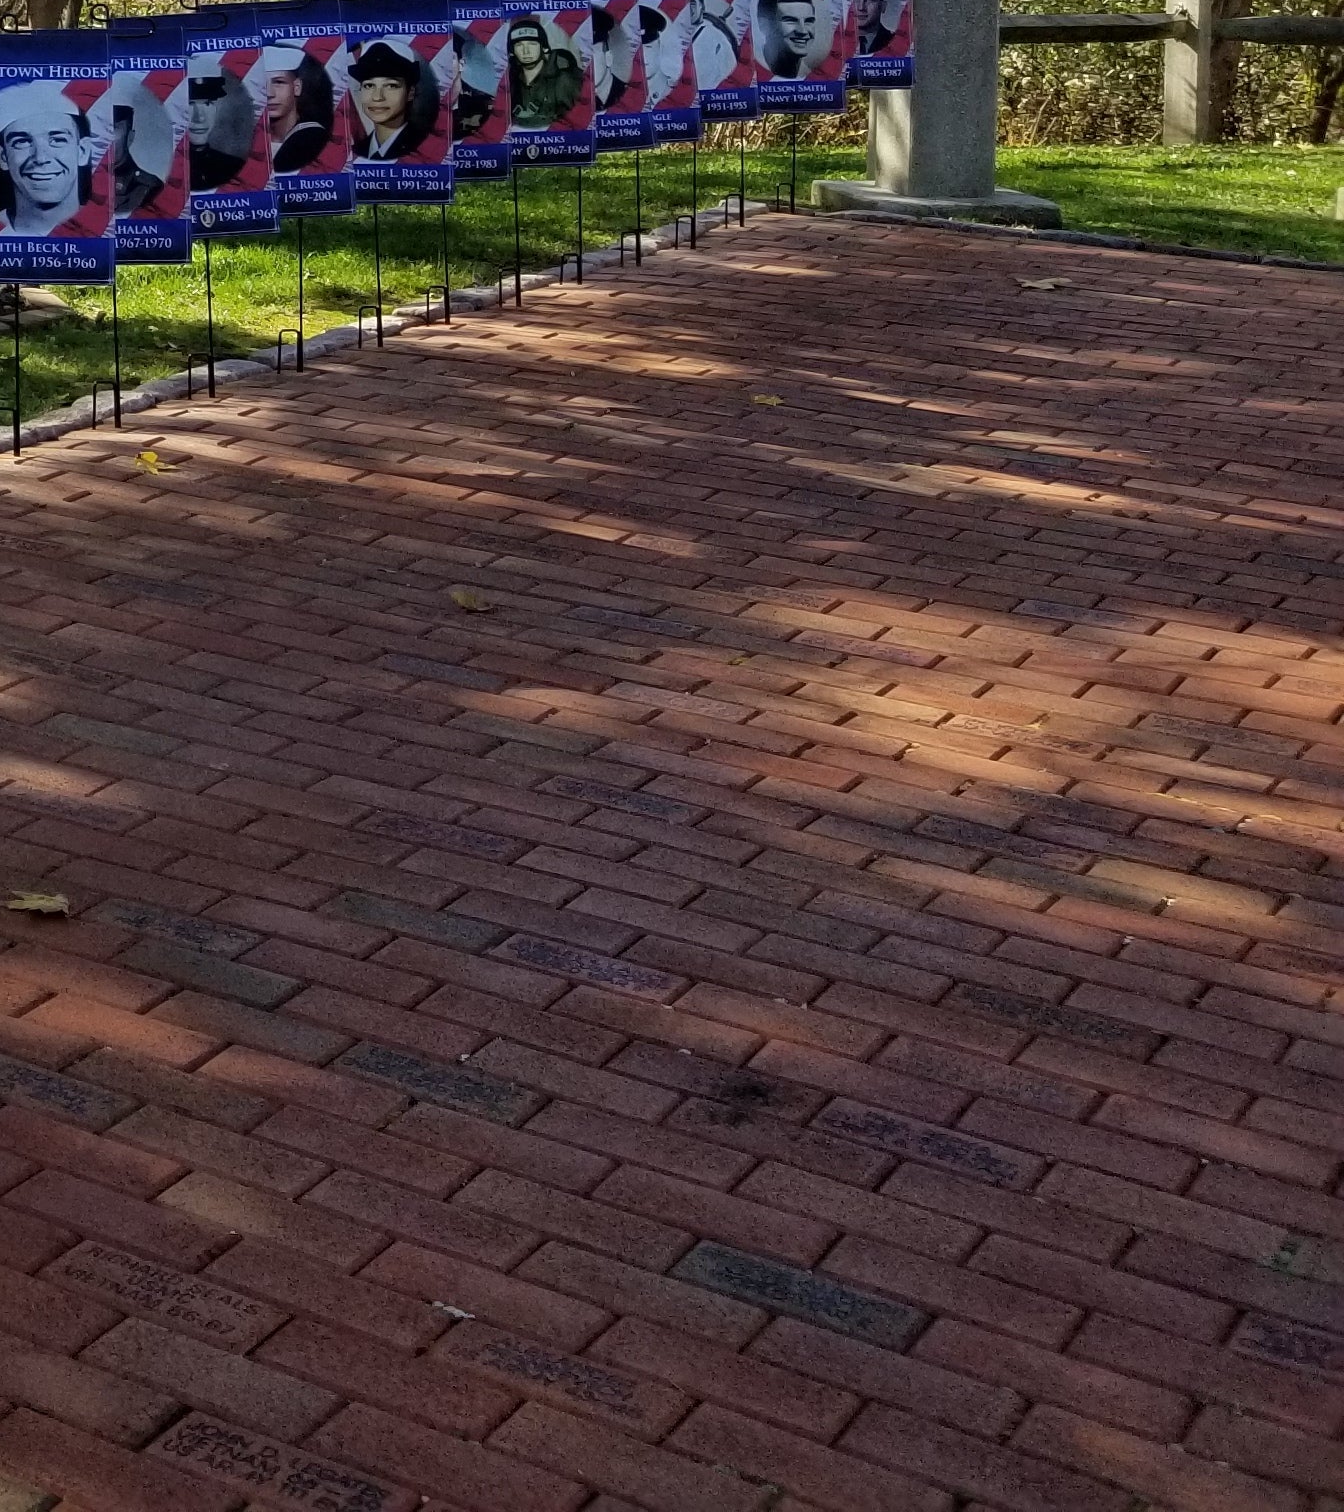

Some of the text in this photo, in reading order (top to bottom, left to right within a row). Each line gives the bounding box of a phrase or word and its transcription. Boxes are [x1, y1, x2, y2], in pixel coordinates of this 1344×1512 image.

[502, 0, 589, 11] TOWN HEROES
[455, 9, 501, 19] HEROES
[289, 26, 340, 37] HEROES
[344, 23, 448, 34] ETOWN HEROES
[206, 38, 259, 50] HEROES
[129, 57, 184, 69] HEROES
[49, 65, 107, 78] HEROES
[760, 84, 827, 93] NELSON SMITH
[710, 92, 739, 101] SMITH
[767, 95, 790, 103] NAVY
[601, 118, 641, 127] LANDON
[534, 135, 565, 144] BANKS
[456, 148, 478, 158] COX
[543, 145, 590, 155] 1967-1968
[454, 159, 497, 169] 978-1983
[354, 169, 386, 178] HANIE
[402, 169, 438, 178] RUSSO
[300, 179, 334, 189] RUSSO
[355, 180, 452, 191] FORCE 1991-2014
[284, 191, 338, 204] 1989-2004
[194, 198, 250, 210] CAHALAN
[219, 208, 278, 222] 1968-1969
[115, 225, 158, 235] HALAN
[27, 243, 61, 253] BECK
[115, 238, 172, 249] 1967-1970
[31, 257, 96, 269] 1956-1960
